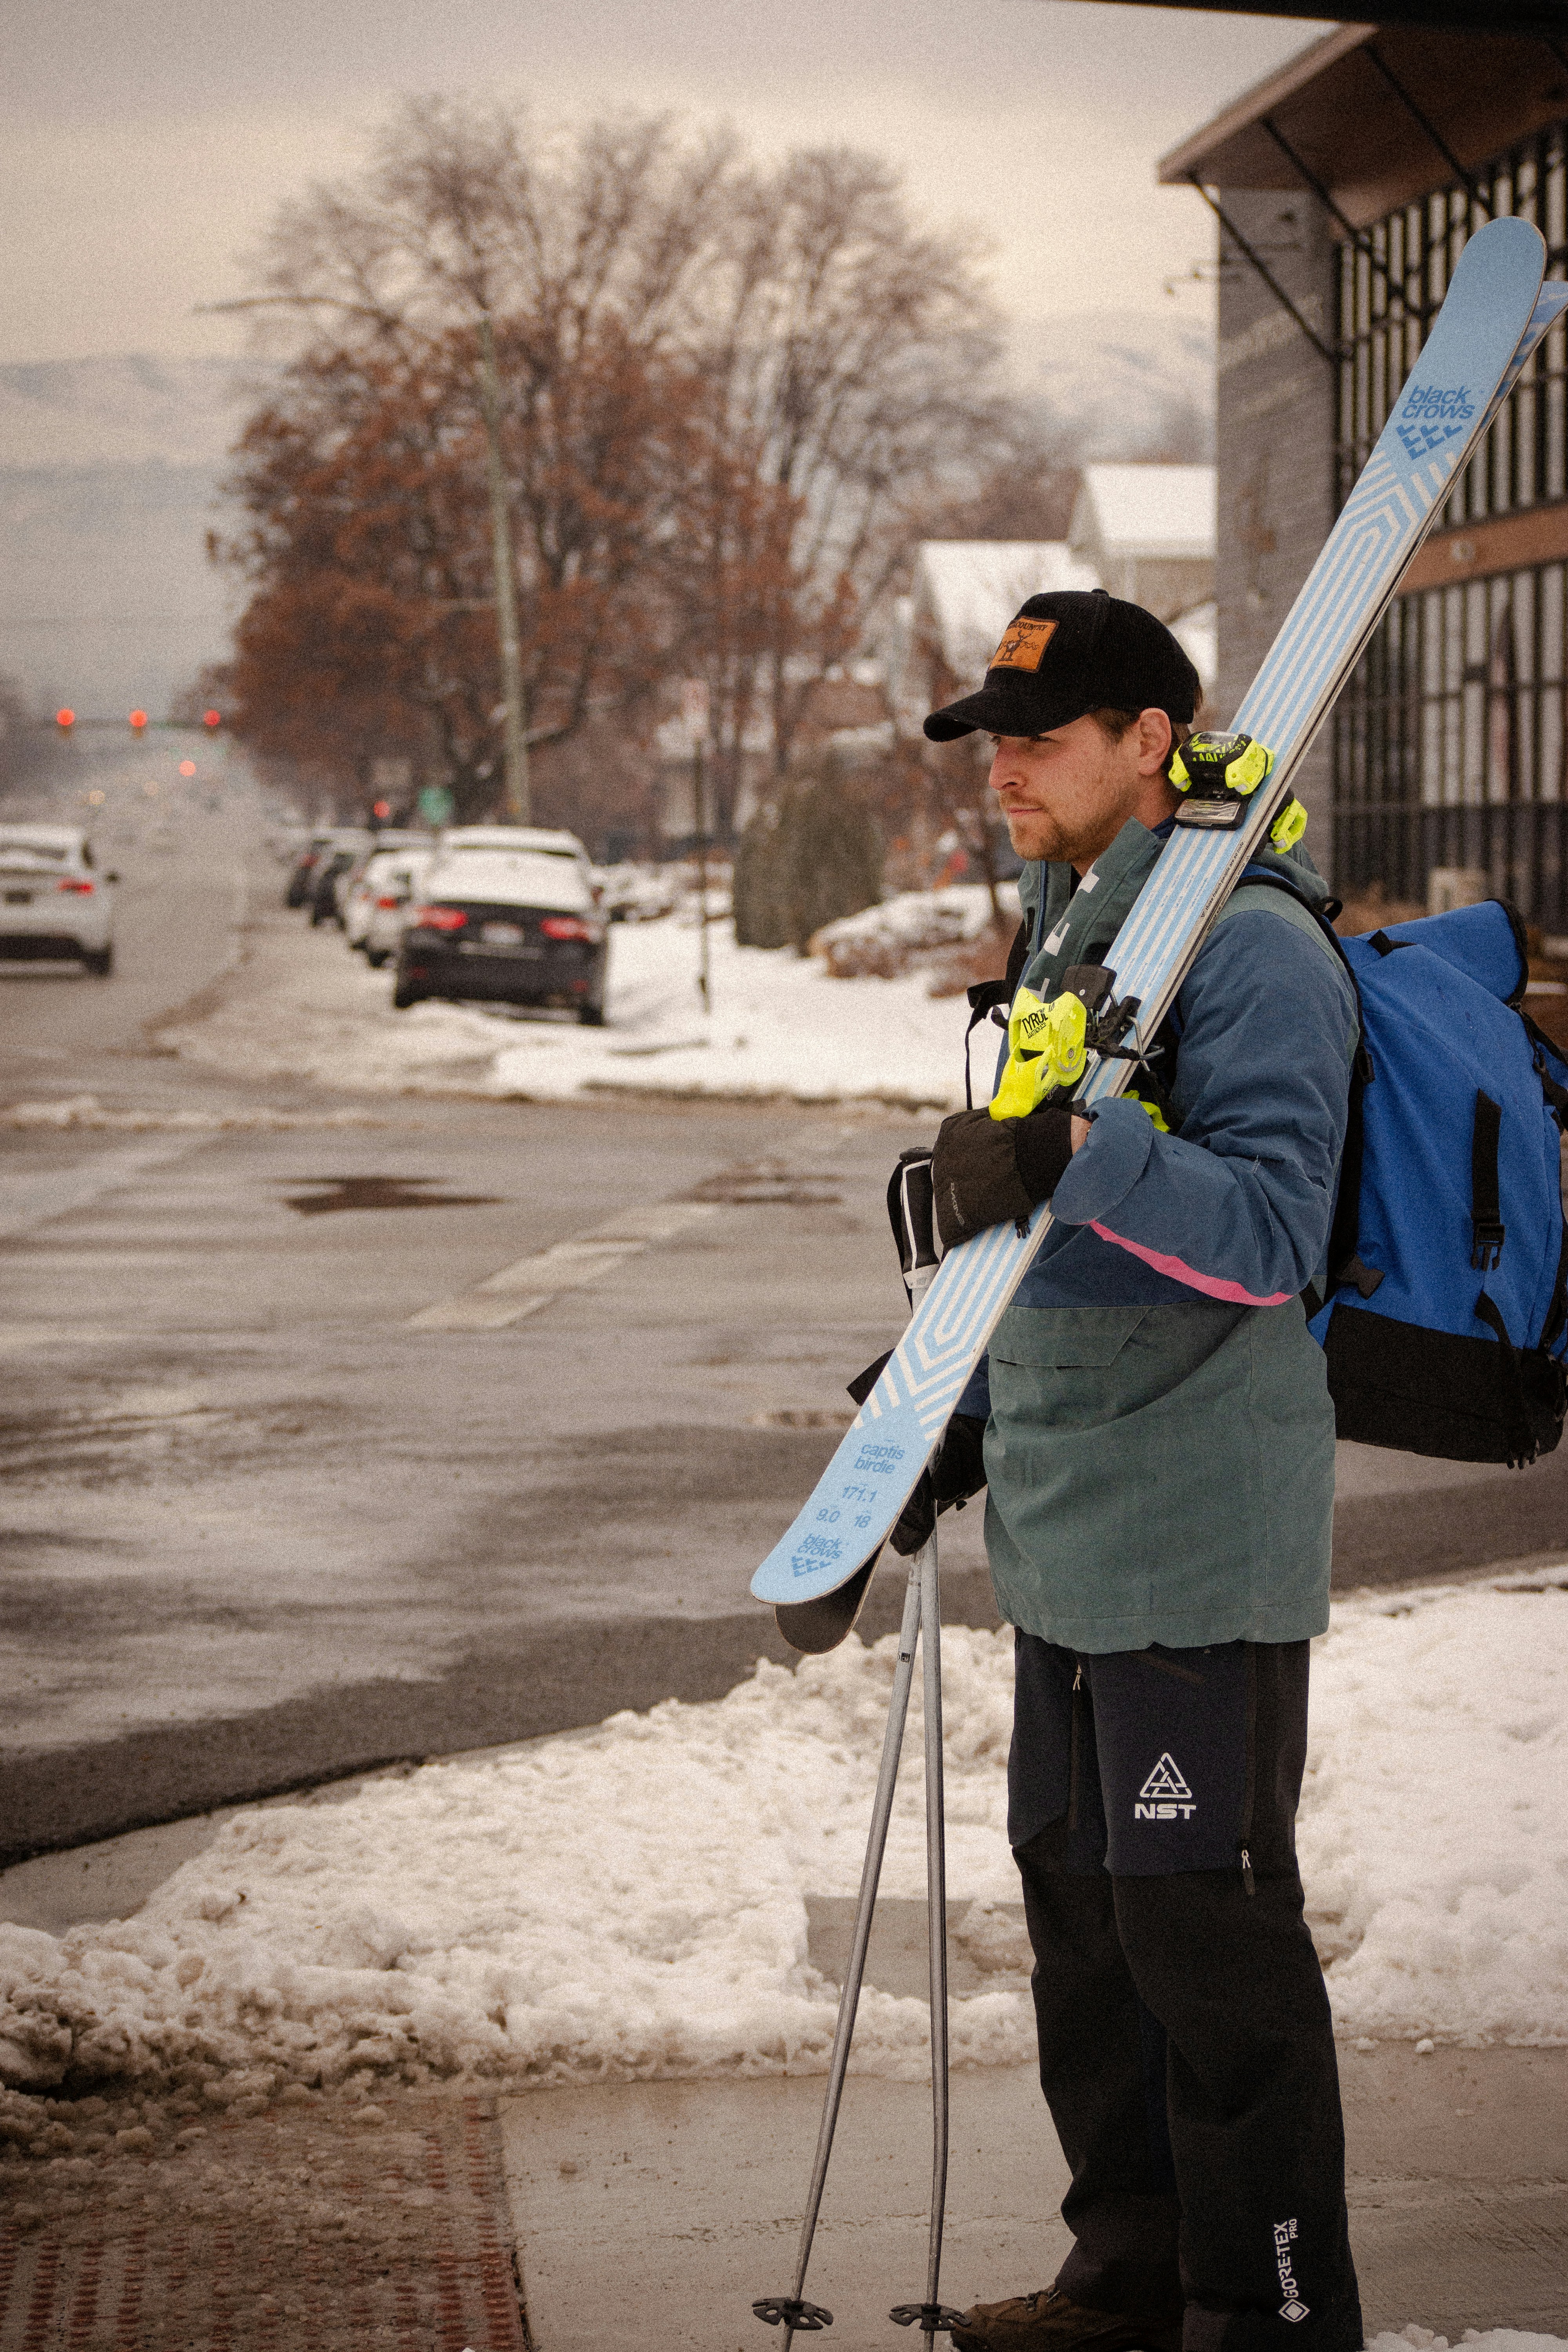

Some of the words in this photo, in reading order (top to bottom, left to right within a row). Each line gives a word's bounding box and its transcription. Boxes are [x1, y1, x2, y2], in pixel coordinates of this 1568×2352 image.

[1408, 385, 1471, 404] black
[1402, 404, 1475, 419] crows
[1213, 884, 1222, 897] french
[1221, 867, 1230, 883] people
[1221, 890, 1230, 906] people
[951, 1183, 964, 1226] DAKINE
[861, 1444, 905, 1459] captis
[854, 1455, 895, 1474] birdie
[842, 1486, 878, 1503] 171.1
[816, 1508, 840, 1523] 9.0
[854, 1514, 871, 1528] 18
[803, 1533, 842, 1549] black
[797, 1544, 842, 1559] crows
[1135, 1804, 1196, 1819] NST
[1289, 2218, 1298, 2239] PRO
[1274, 2221, 1299, 2298] GORE-TEX
